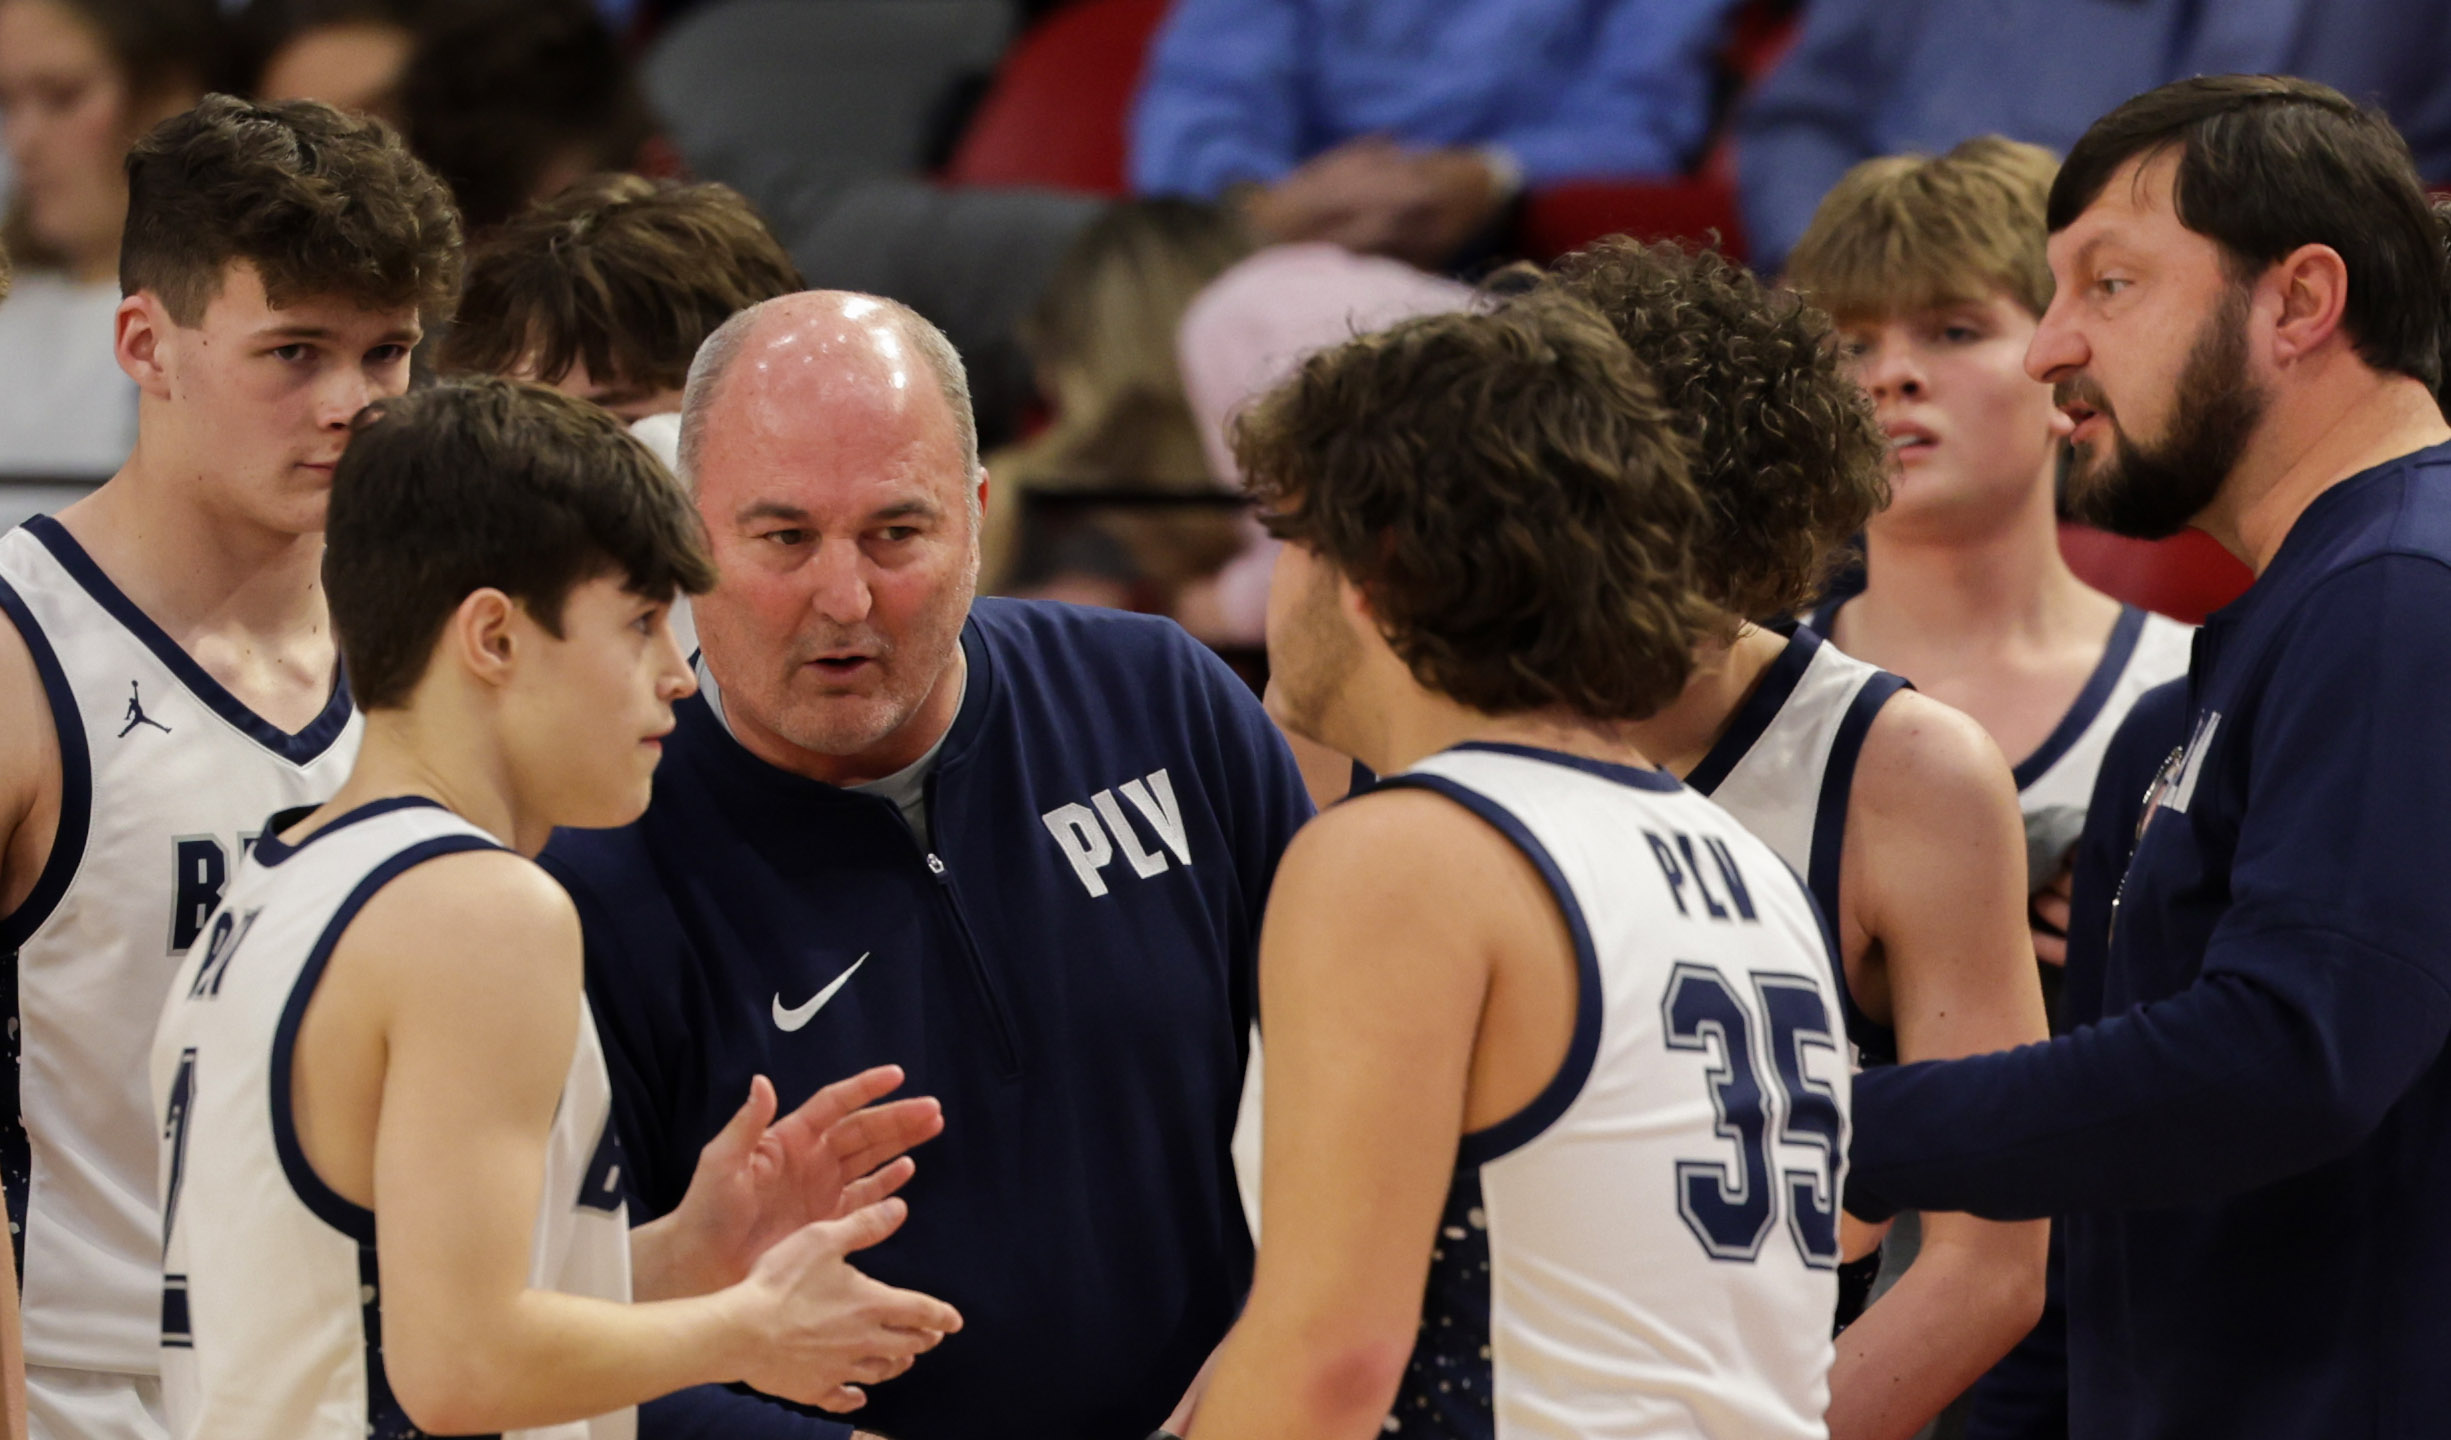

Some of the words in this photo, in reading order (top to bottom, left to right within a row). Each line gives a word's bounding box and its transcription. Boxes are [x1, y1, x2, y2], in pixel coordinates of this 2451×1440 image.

[166, 832, 262, 957] B
[1042, 767, 1193, 898] PLV
[1643, 831, 1759, 921] PLV
[1661, 962, 1848, 1269] 35
